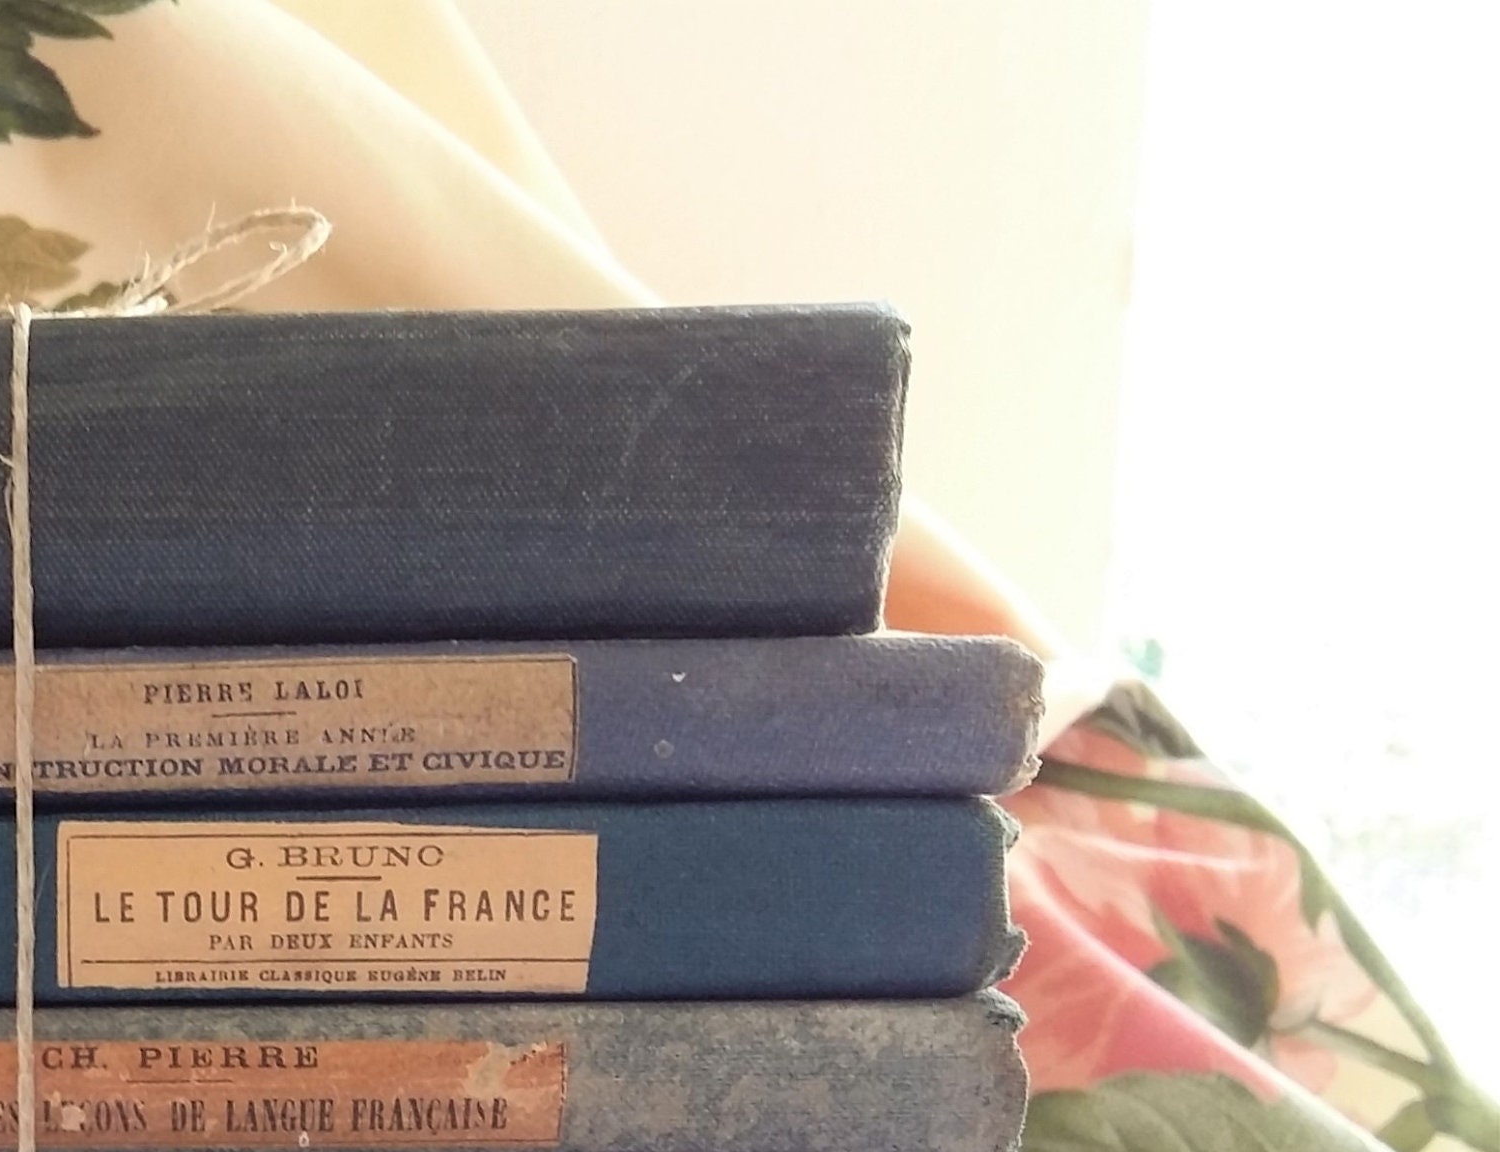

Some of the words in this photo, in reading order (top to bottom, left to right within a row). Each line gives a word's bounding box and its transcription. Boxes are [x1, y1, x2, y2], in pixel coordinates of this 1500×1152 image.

[143, 682, 253, 704] PIERRE
[90, 734, 123, 750] LA
[146, 725, 299, 748] PREMIÈRE
[217, 755, 357, 775] MORALE
[367, 753, 414, 772] ET
[422, 750, 566, 771] CIVIQUE
[226, 847, 264, 869] G.
[94, 891, 135, 923] LE
[156, 891, 259, 923] TOUR
[286, 890, 330, 922] DE
[356, 889, 399, 922] LA
[424, 889, 578, 922] FRANCE
[208, 935, 254, 952] PAR
[270, 934, 334, 951] DEUX
[349, 933, 455, 951] ENFANTS
[155, 970, 250, 984] LIBRAIRIE
[259, 968, 358, 983] CLASSIQUE
[367, 965, 442, 983] EUGÈNE
[452, 967, 508, 982] BELIN
[41, 1046, 108, 1071] CH.
[139, 1045, 320, 1069] PIERRE
[170, 1099, 206, 1132] DE
[225, 1098, 335, 1132] LANGUE
[352, 1097, 509, 1135] FRANÇAISE
